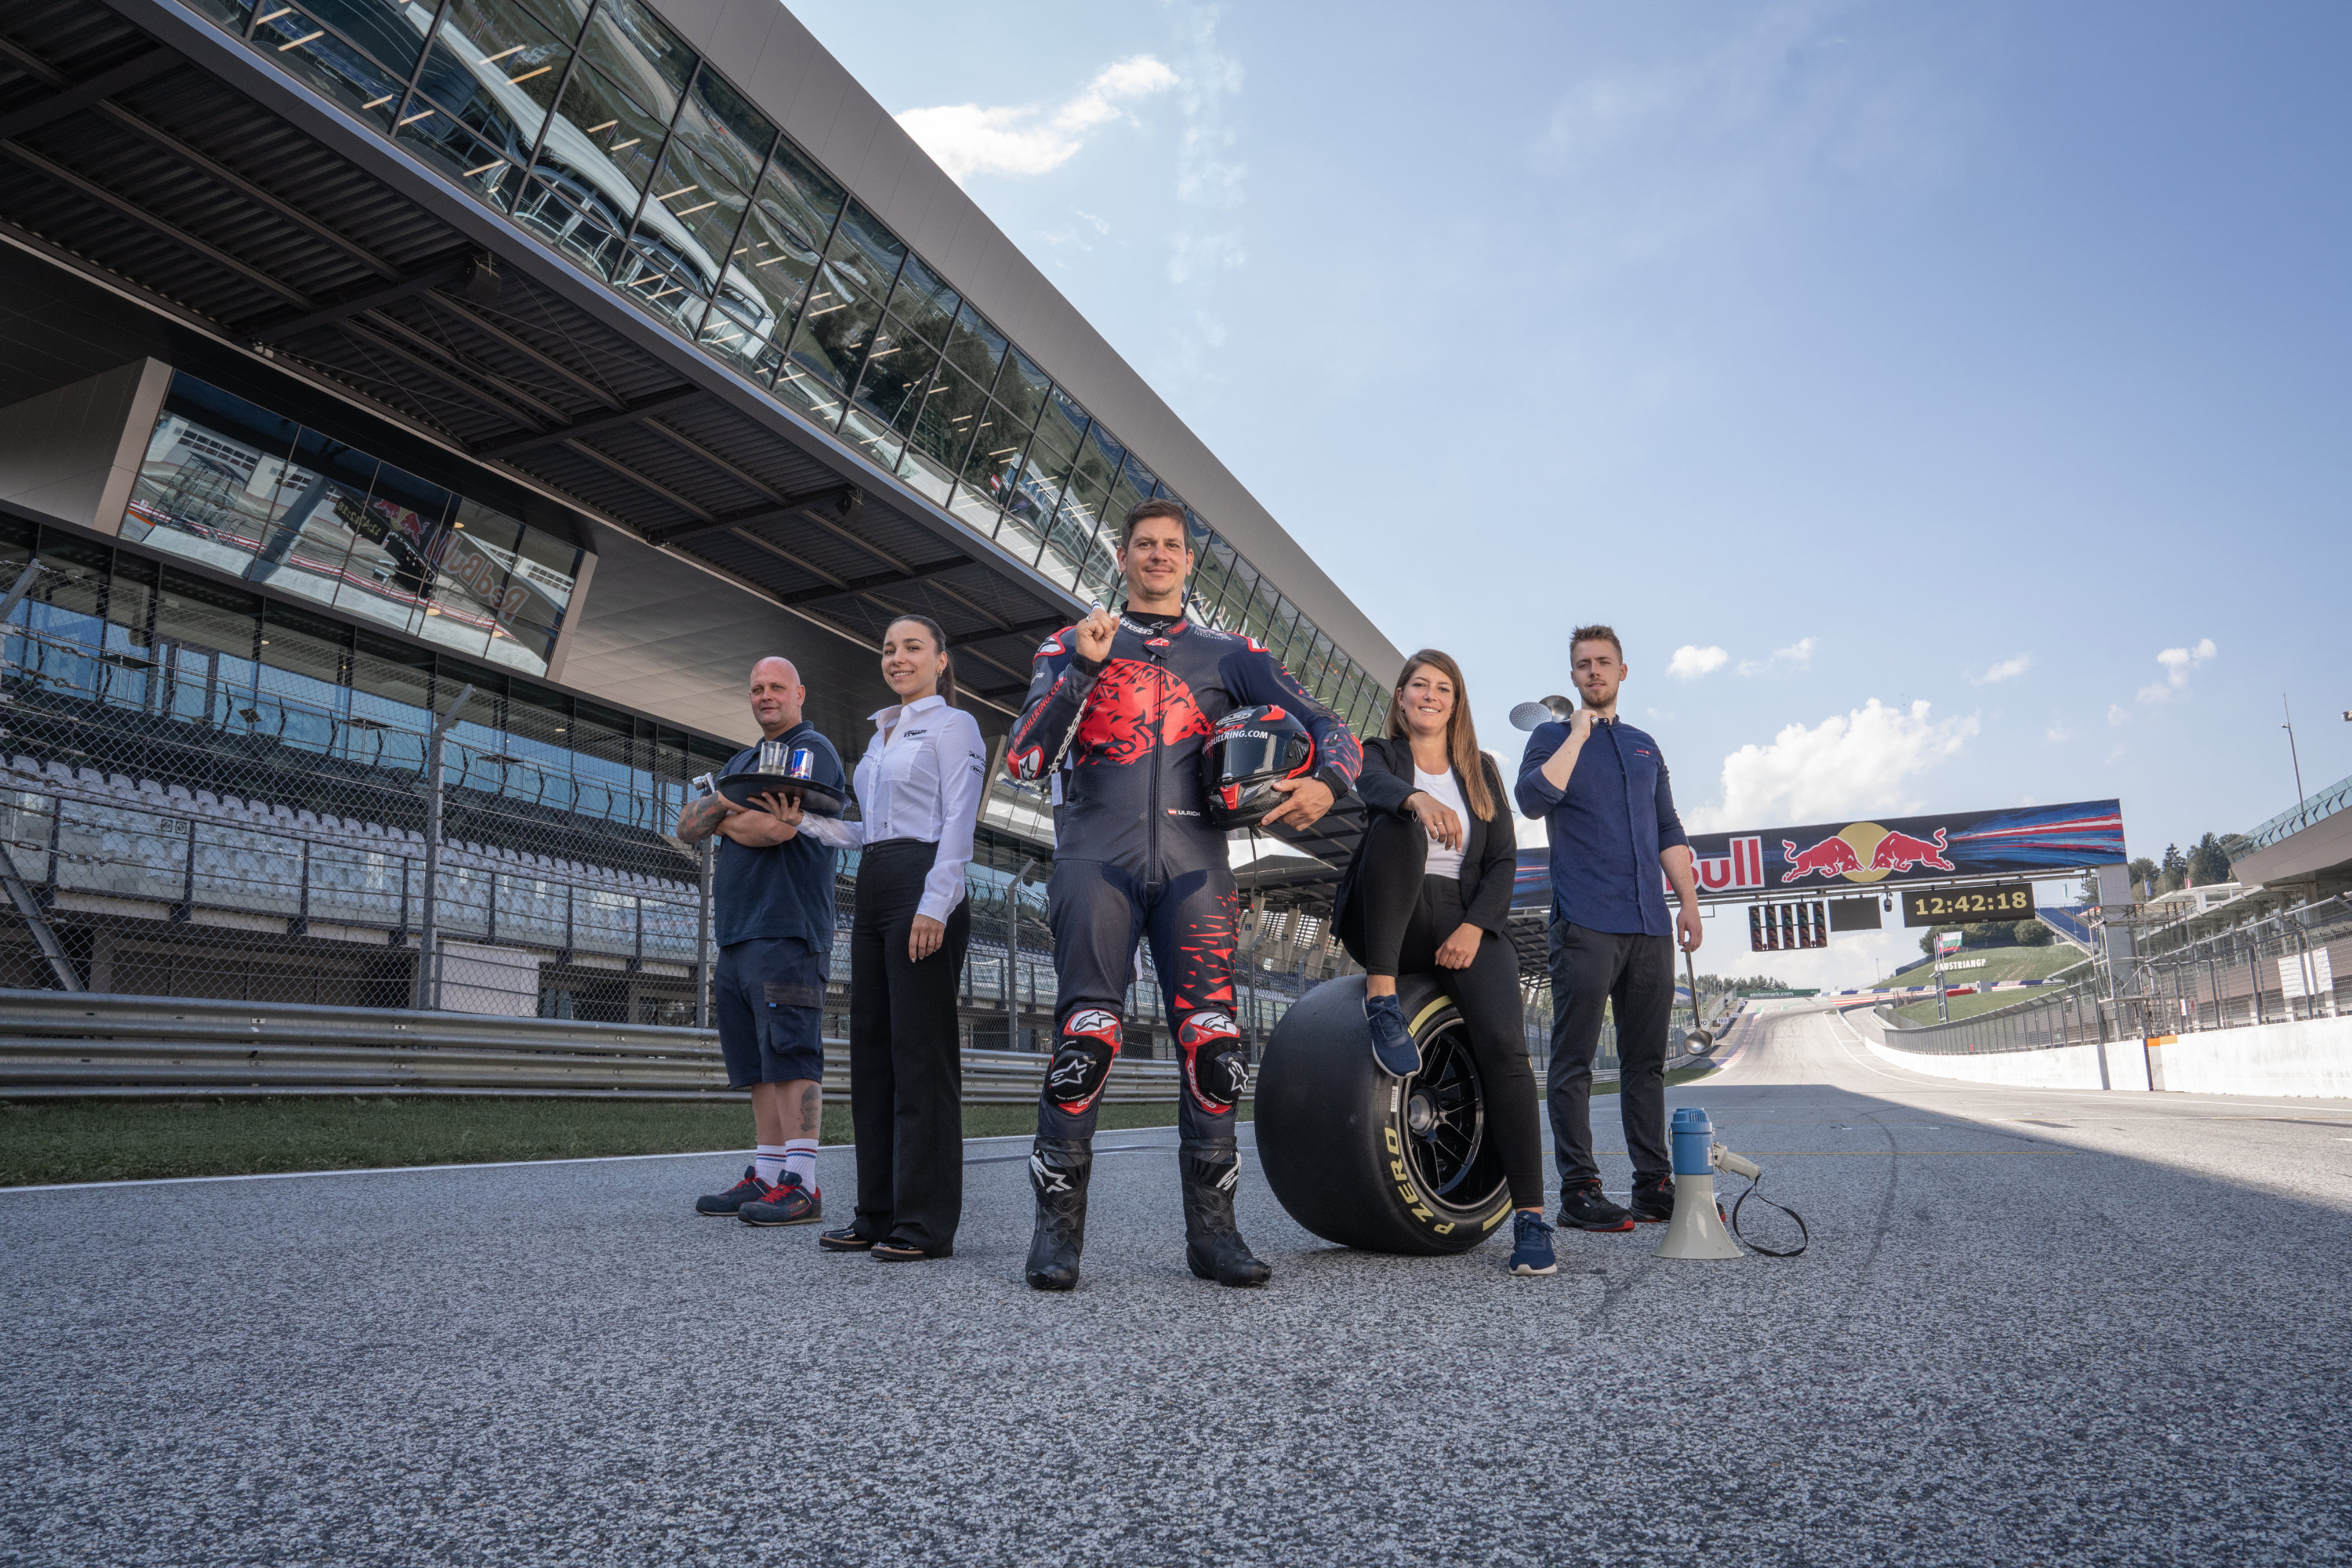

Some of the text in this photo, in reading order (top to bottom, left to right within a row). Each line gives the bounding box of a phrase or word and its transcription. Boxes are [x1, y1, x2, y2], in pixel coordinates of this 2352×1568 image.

[1120, 617, 1154, 635] lpinestars
[1014, 675, 1066, 752] REDBULLRING.COM
[1047, 698, 1088, 775] pinestars
[1202, 730, 1269, 755] REDBULLRING.COM
[1915, 891, 2027, 916] 12:42:18
[1385, 1127, 1456, 1235] P ZERO
